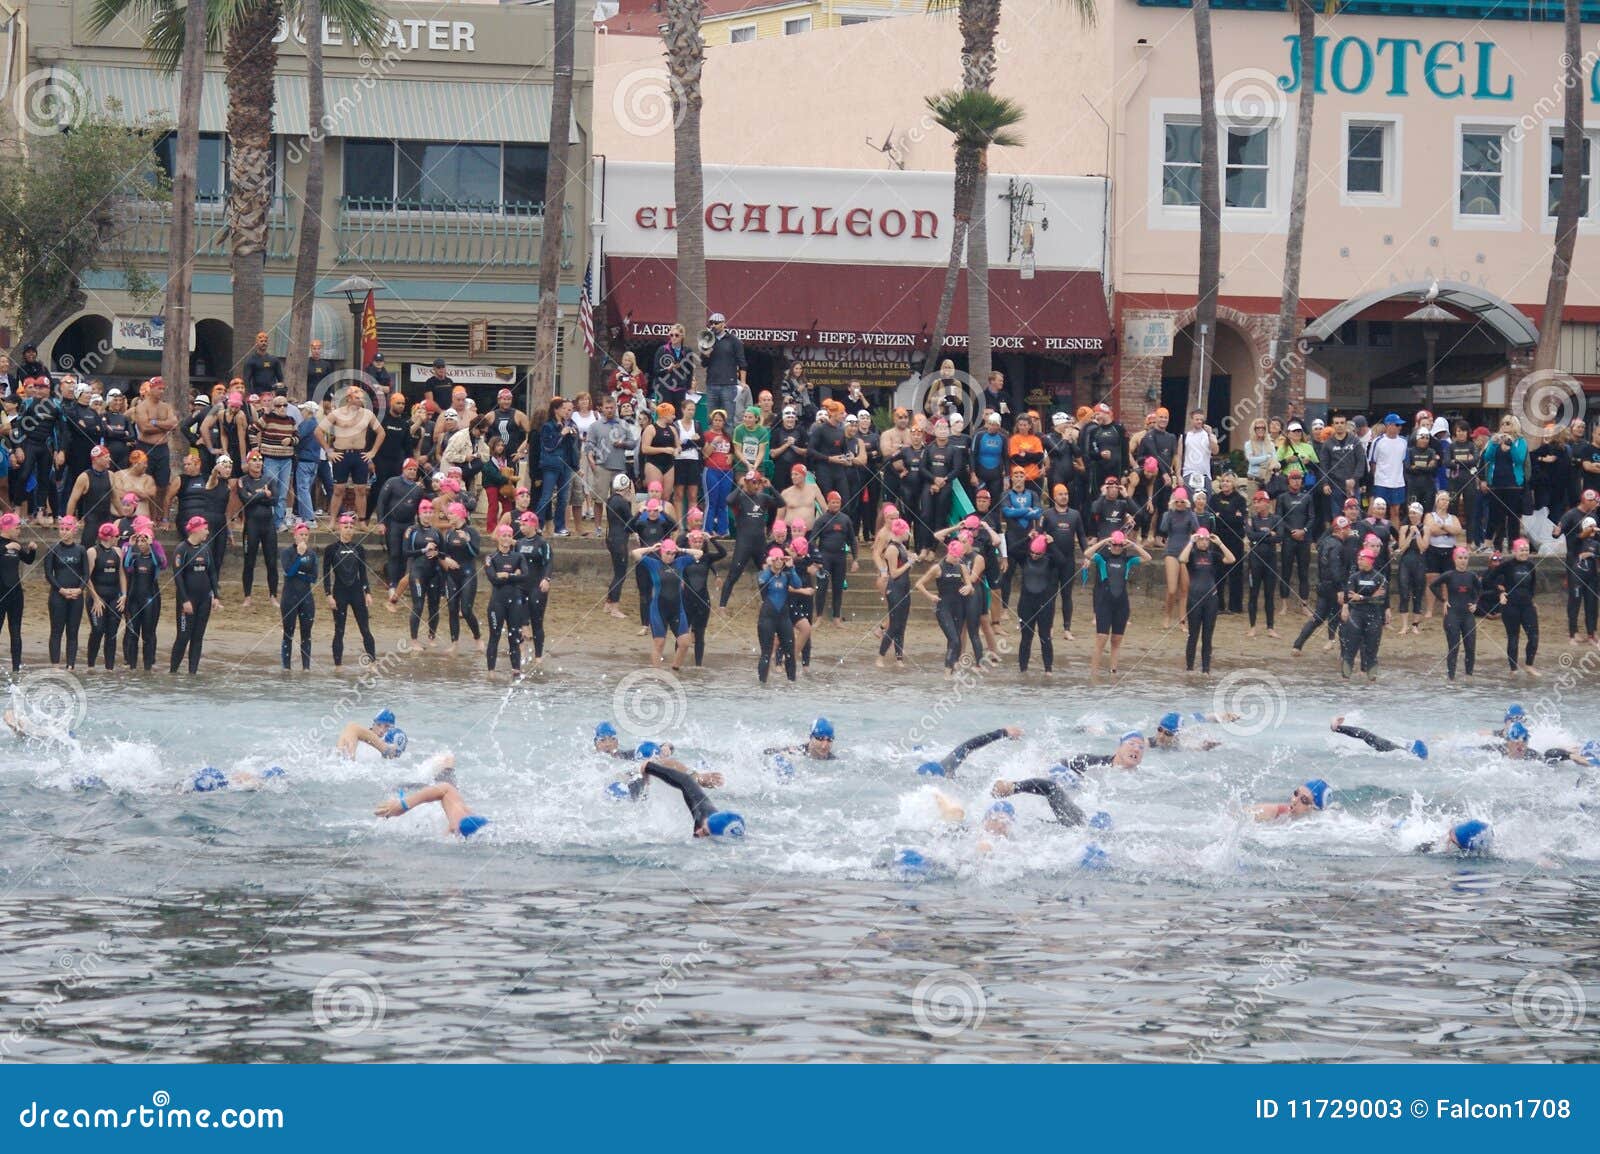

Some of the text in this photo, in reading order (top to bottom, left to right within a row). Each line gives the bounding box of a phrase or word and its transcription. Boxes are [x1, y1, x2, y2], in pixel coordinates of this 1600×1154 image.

[1277, 34, 1515, 101] HOTEL
[704, 202, 939, 240] GALLEON
[1389, 265, 1490, 288] AVALON
[632, 323, 672, 336] LAGE
[724, 328, 799, 342] OBERFEST
[818, 331, 916, 346] HEFE-WEIZEN
[941, 335, 1024, 349] OPPBOCK
[1045, 337, 1103, 350] PILSNER
[841, 361, 911, 370] HEADQUARTERS
